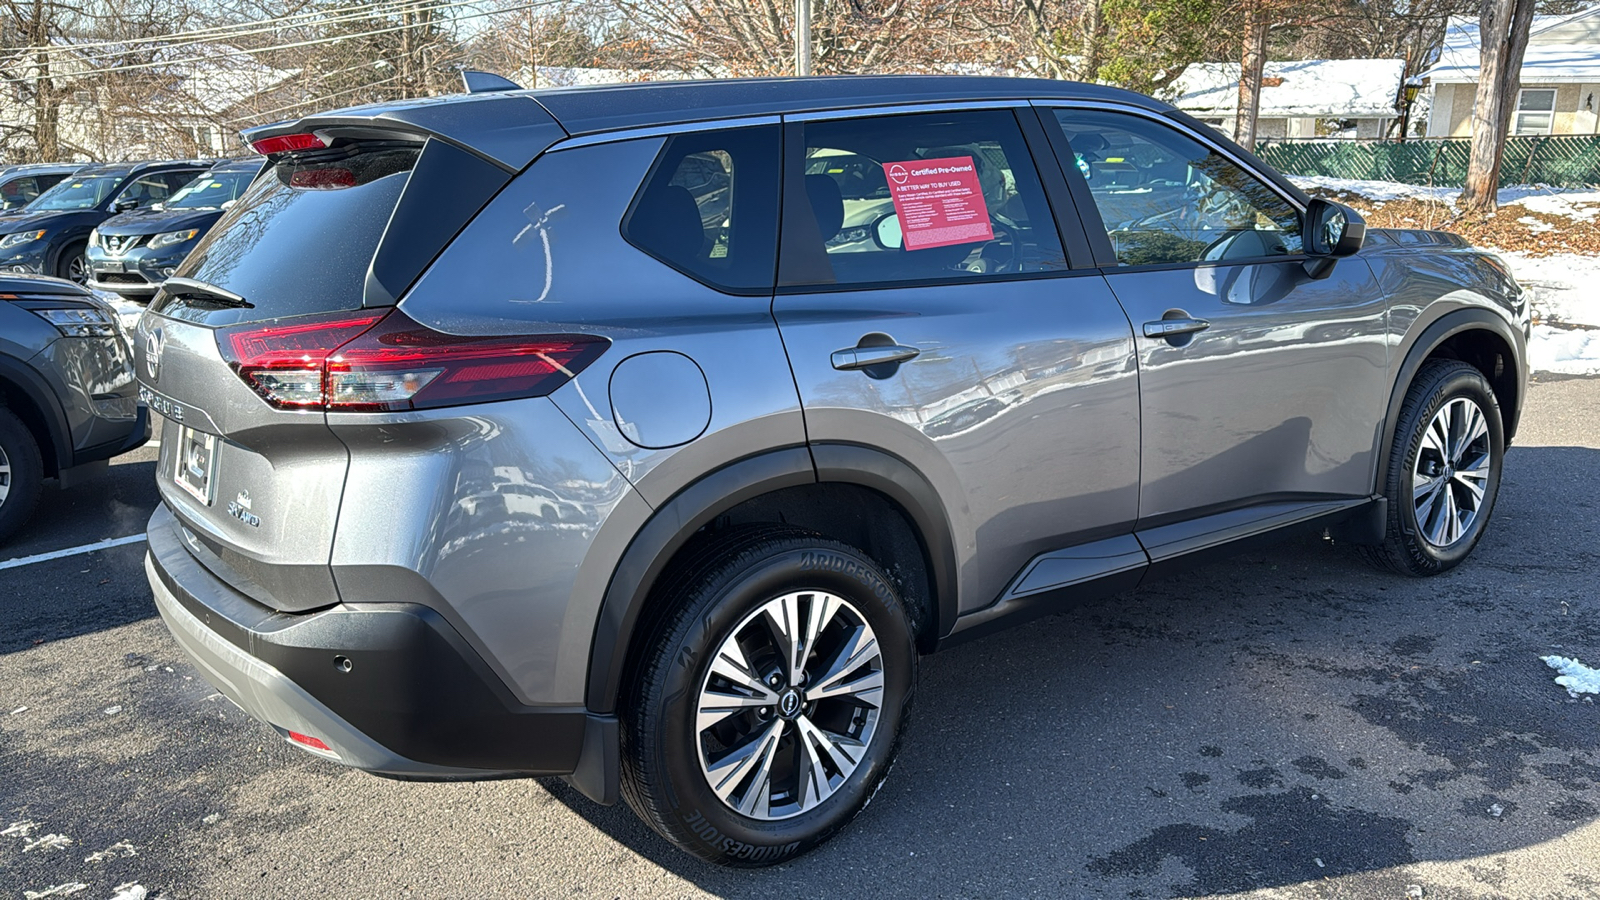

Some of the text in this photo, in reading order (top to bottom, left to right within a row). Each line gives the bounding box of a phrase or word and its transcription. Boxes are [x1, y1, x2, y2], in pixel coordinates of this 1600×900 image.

[911, 164, 972, 176] Certified Pre-Owned
[1402, 385, 1446, 472] BRIDGESTONE
[1407, 538, 1436, 568] ALENZA
[799, 551, 899, 616] BRIDGESTONE
[682, 808, 800, 861] BRIDGESTONE
